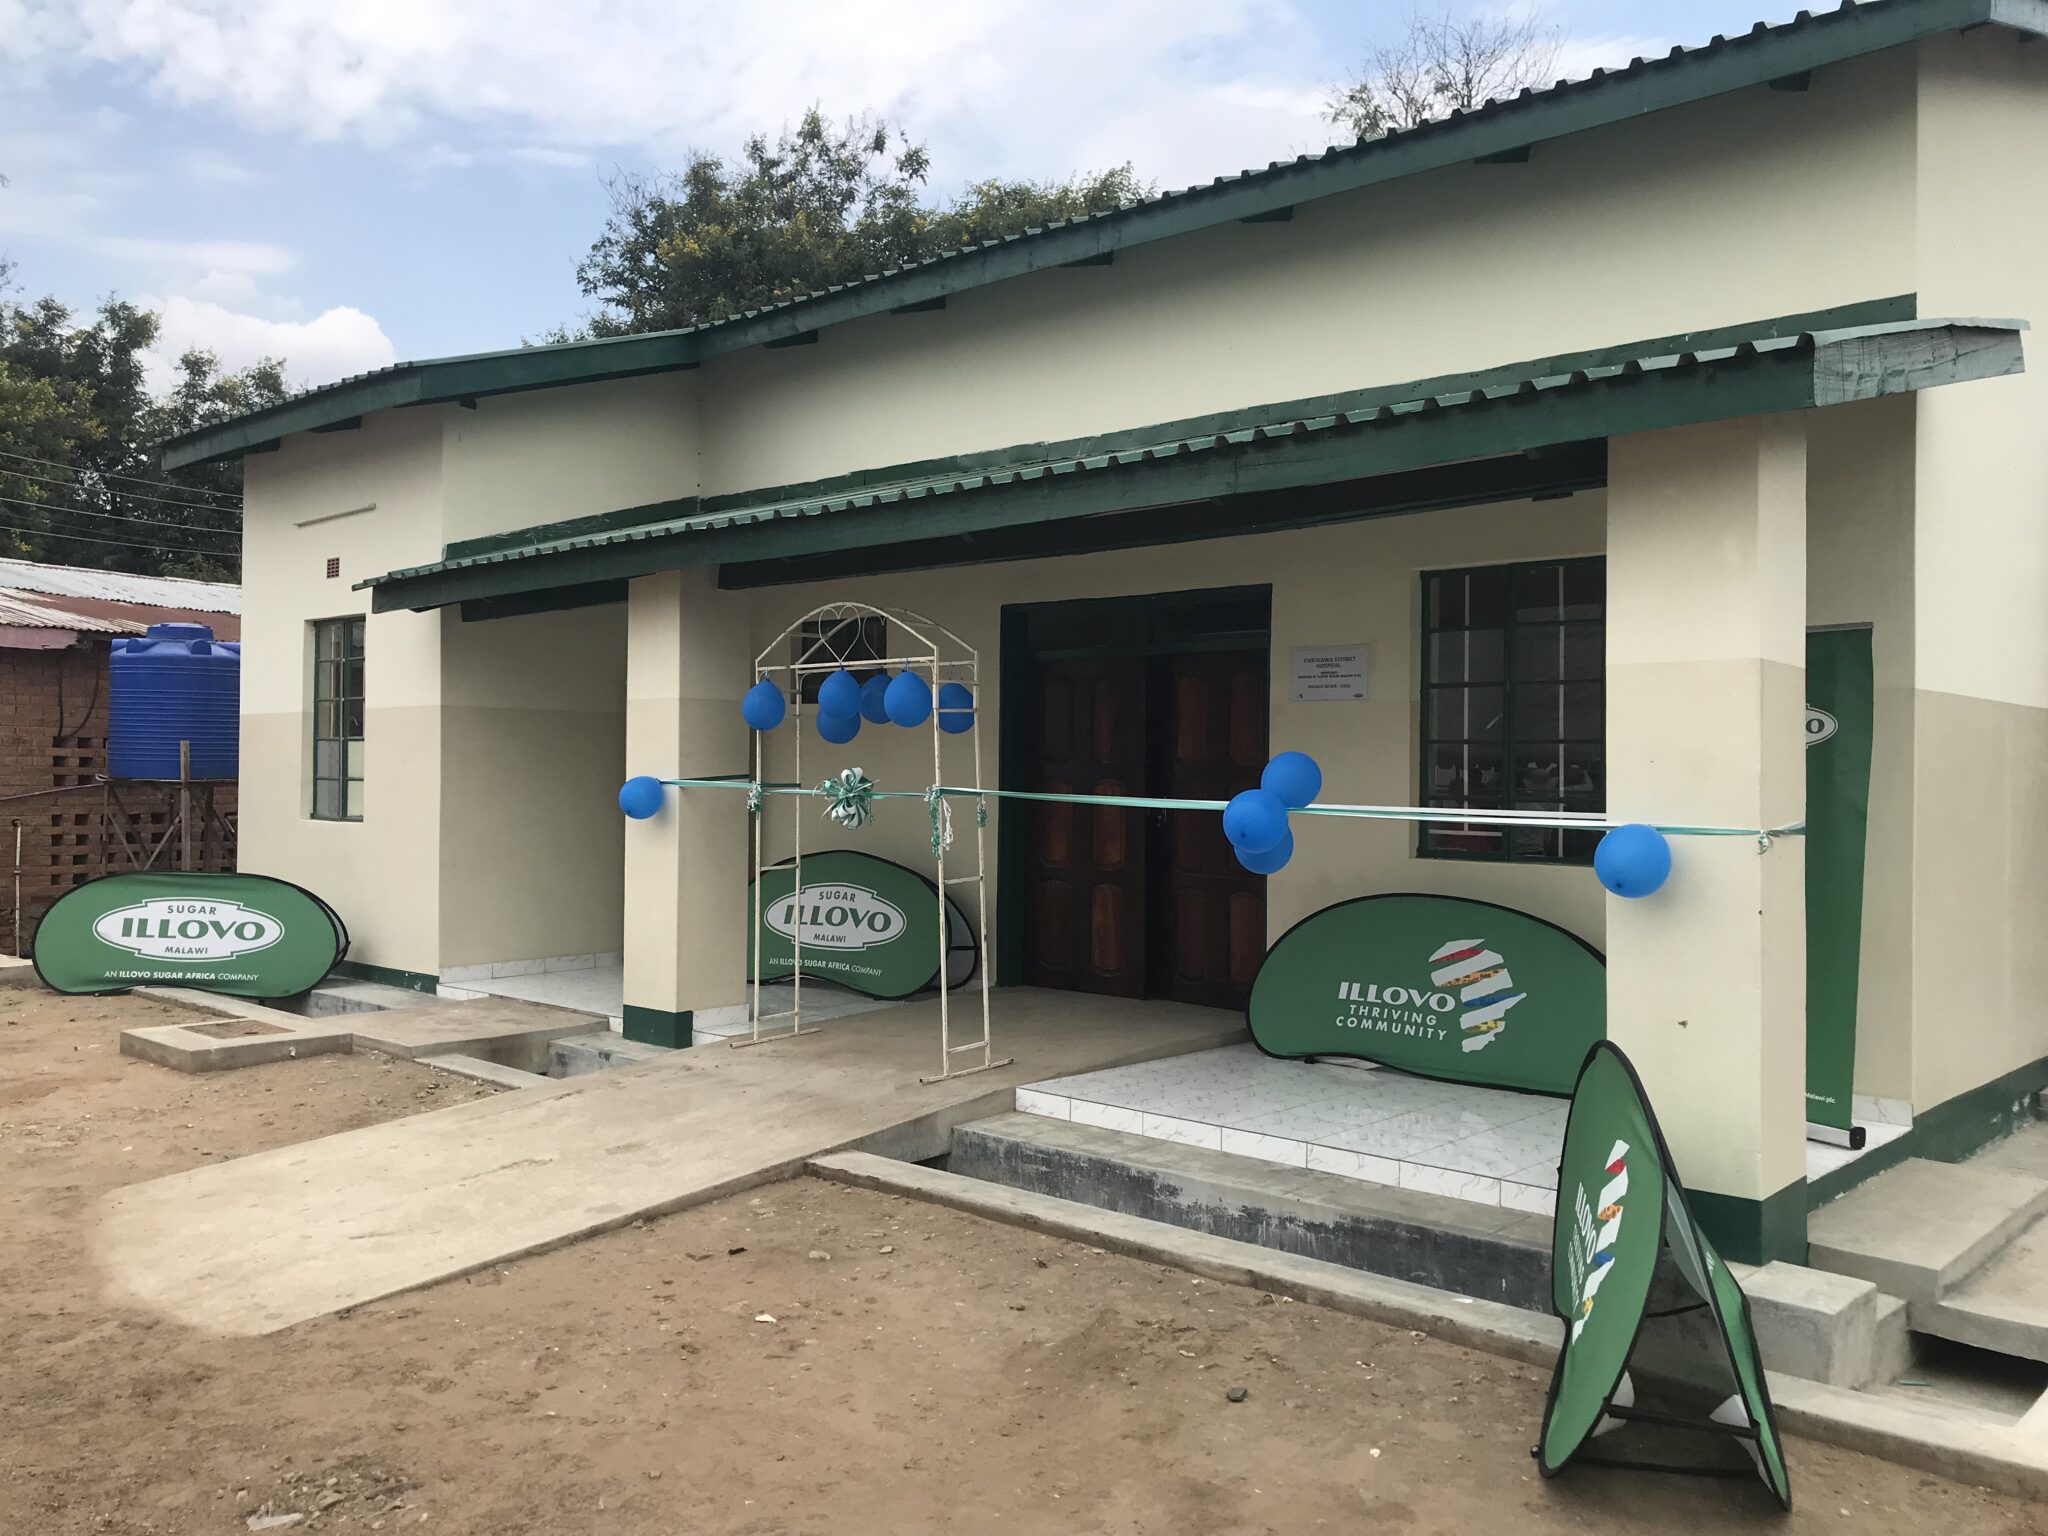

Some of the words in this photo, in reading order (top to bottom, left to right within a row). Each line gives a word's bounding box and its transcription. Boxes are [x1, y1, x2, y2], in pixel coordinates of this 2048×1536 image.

[819, 891, 856, 902] SUGAR
[167, 905, 217, 915] SUGAR
[783, 904, 892, 933] ILLOVO
[121, 917, 266, 941] ILLOVO
[813, 933, 847, 943] MALAWI
[164, 946, 209, 955] MALAWI
[104, 970, 118, 978] AN
[119, 971, 151, 979] ILLOVO
[185, 972, 216, 980] AFRICA
[217, 973, 260, 981] COMPANY
[803, 959, 827, 968] SUGAR
[827, 961, 851, 971] AFRICA
[851, 964, 883, 977] COMPANY
[1338, 981, 1456, 1012] ILLOVO
[1349, 1004, 1437, 1026] THRIVING
[1335, 1016, 1448, 1041] COMMUNITY
[1575, 1181, 1597, 1265] ILLOVO
